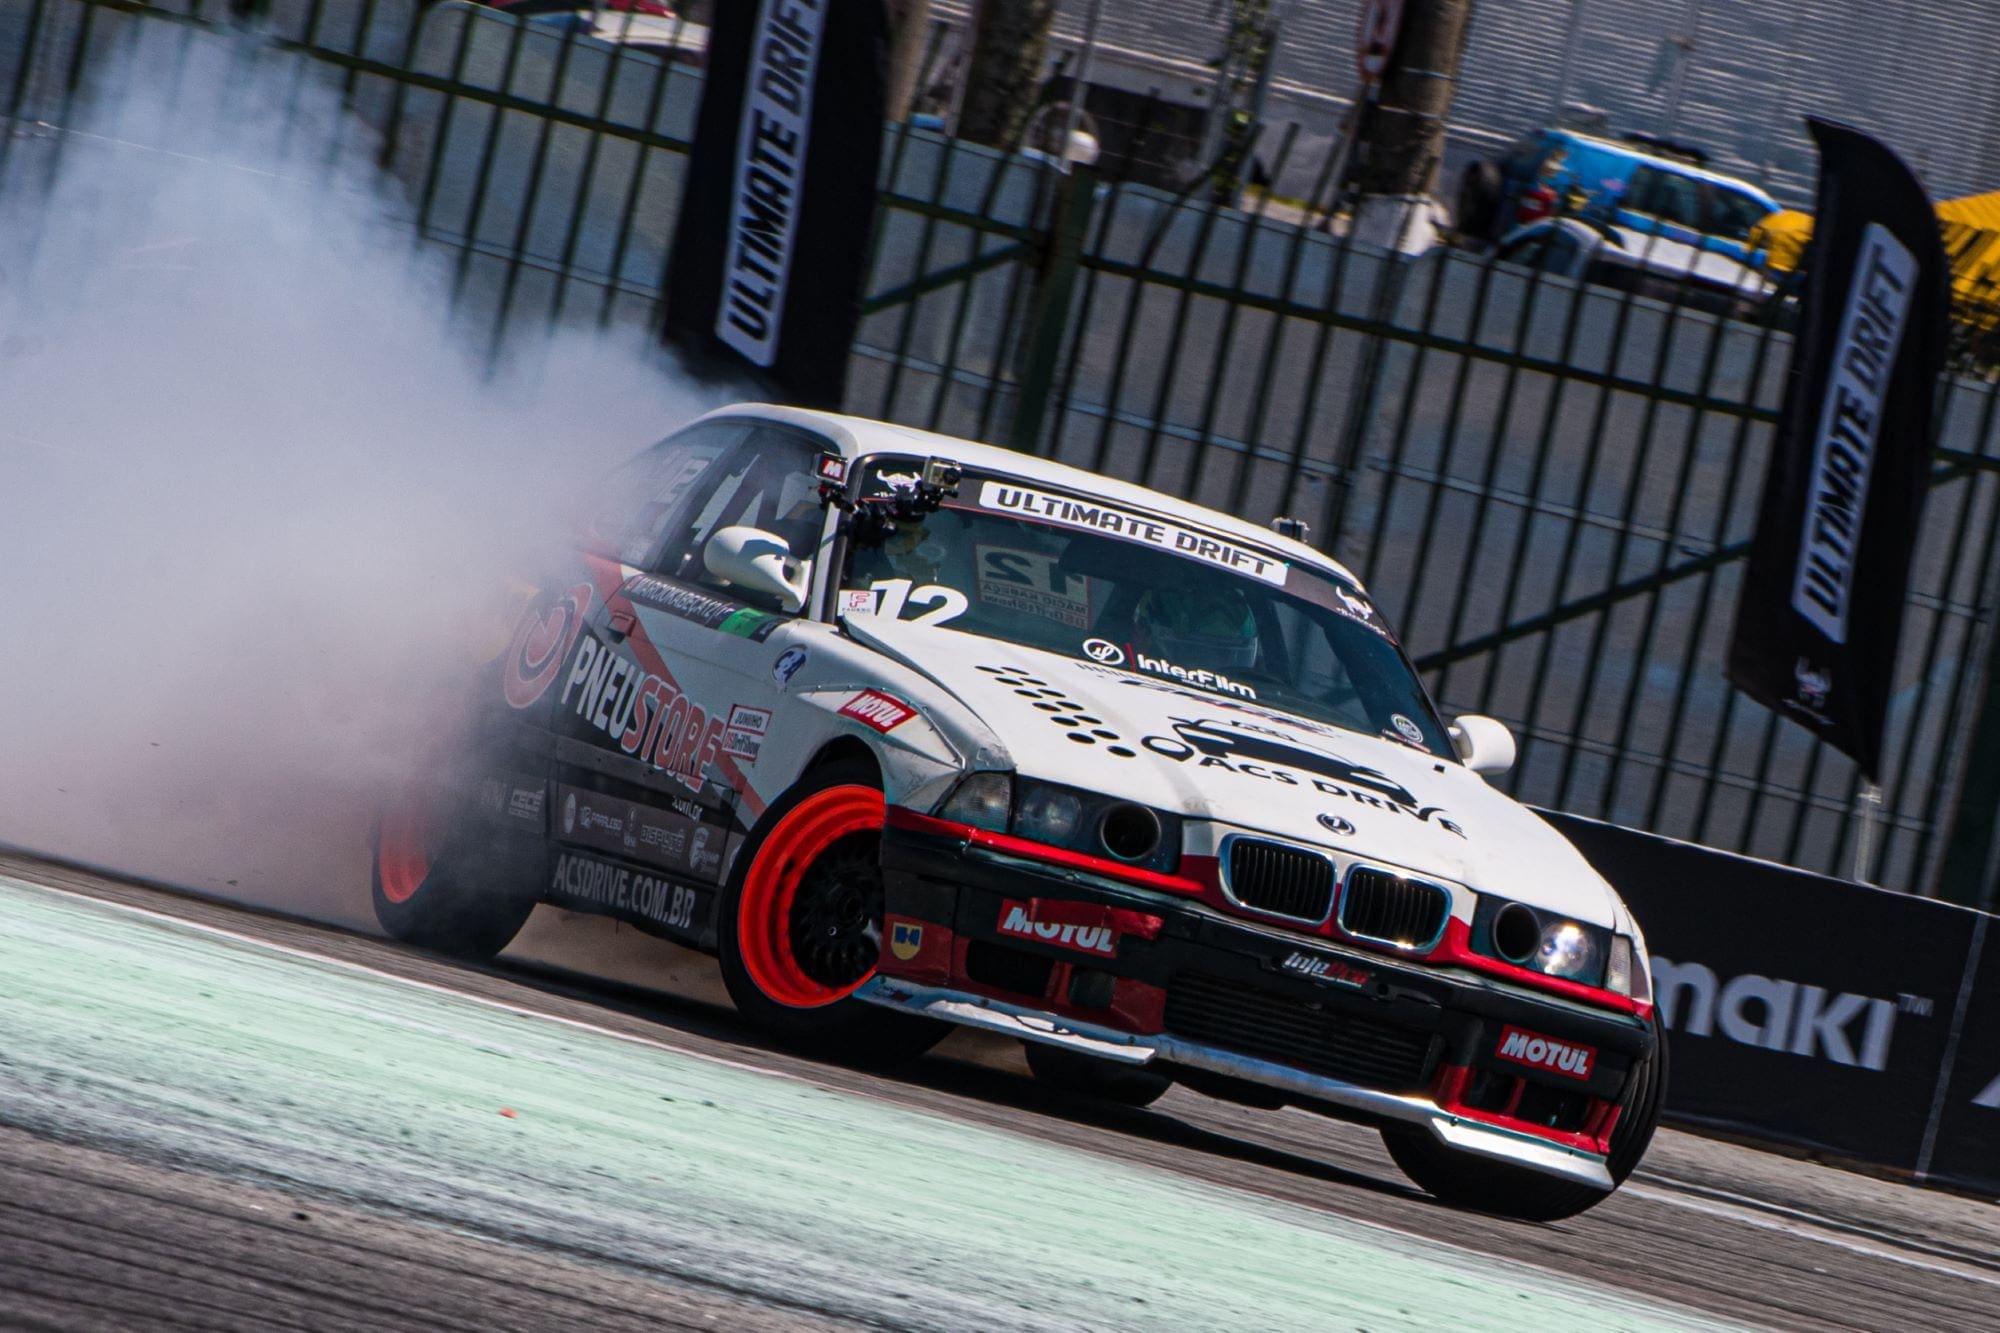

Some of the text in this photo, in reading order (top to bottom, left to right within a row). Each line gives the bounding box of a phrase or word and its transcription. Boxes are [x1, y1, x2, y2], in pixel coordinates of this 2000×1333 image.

[727, 0, 817, 342] ULTIMATE DRIF
[1805, 242, 1904, 619] ULTIMATE DRIFT
[996, 488, 1275, 576] ULTIMATE DRIFT
[870, 578, 969, 627] 12
[560, 634, 728, 794] PNEUSTORE
[846, 694, 907, 728] MOTUL
[1137, 653, 1257, 700] InterFilm
[1199, 756, 1468, 840] ACS DRIVE
[552, 853, 696, 929] ACSDRIVE.COM.BR
[1003, 906, 1114, 953] MOTUL
[1500, 1032, 1589, 1075] MOTUL
